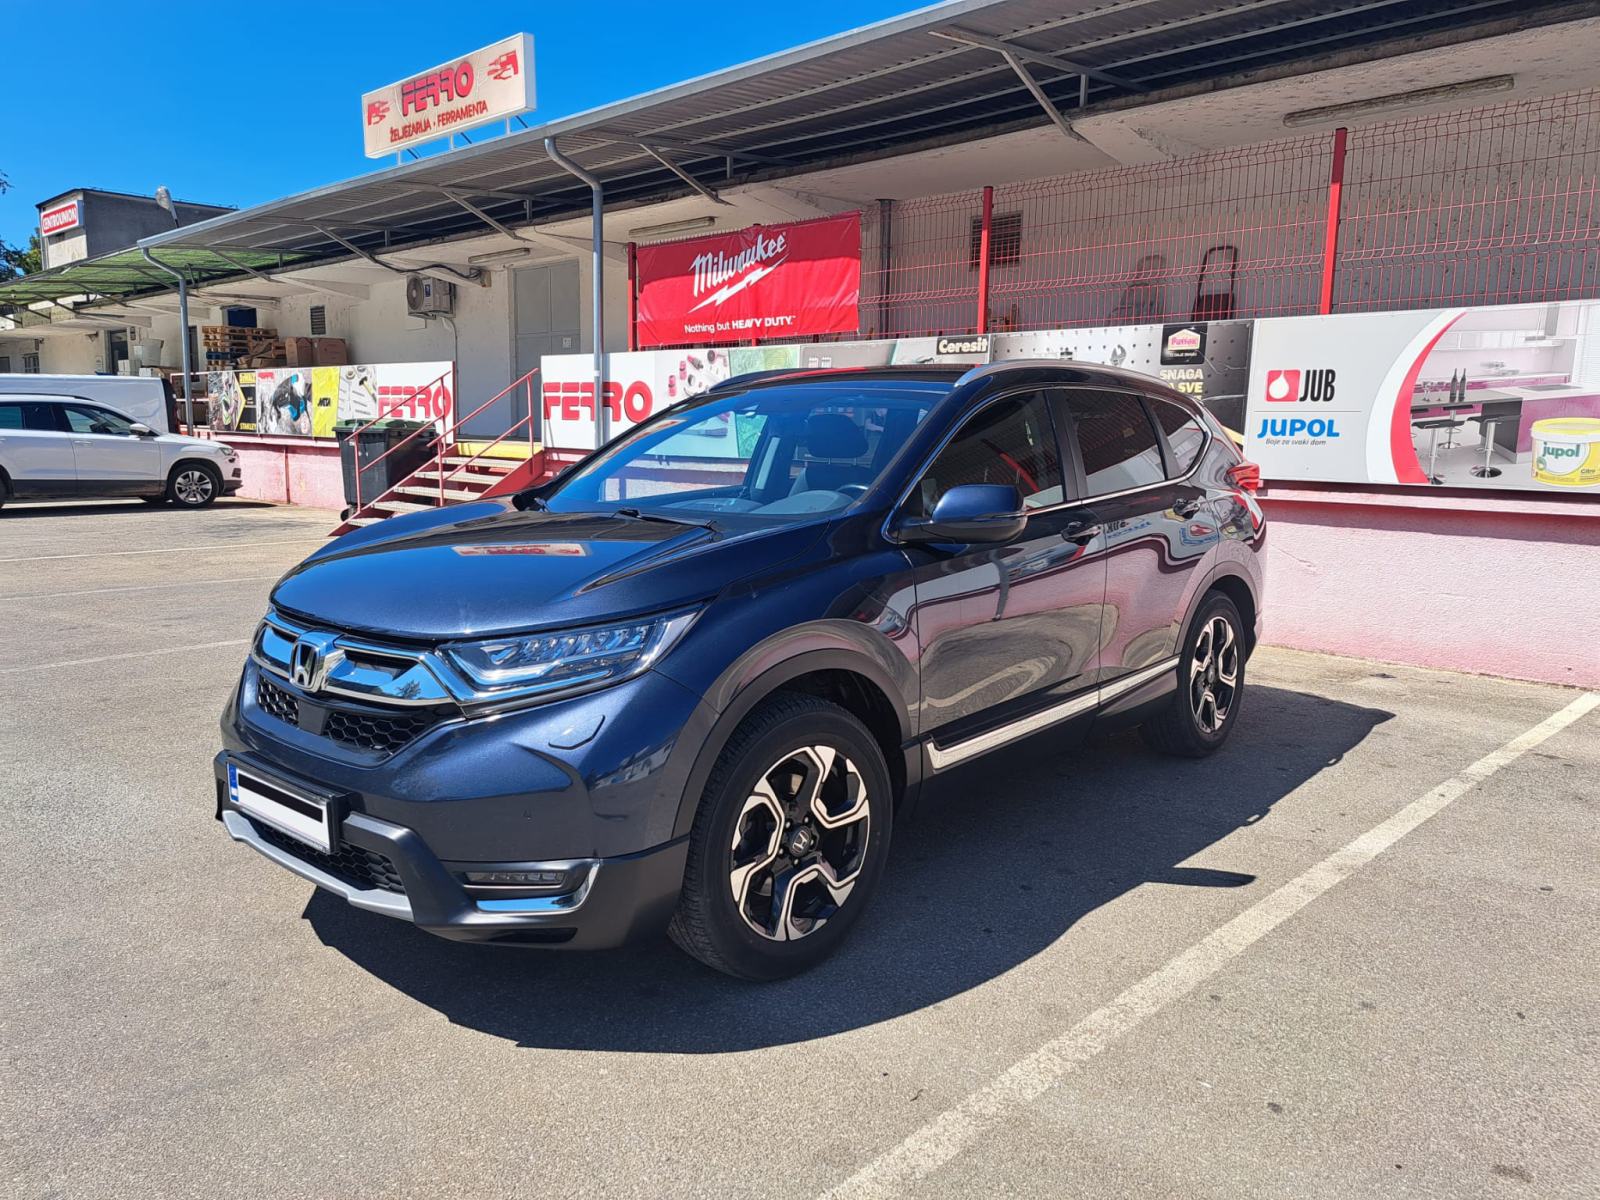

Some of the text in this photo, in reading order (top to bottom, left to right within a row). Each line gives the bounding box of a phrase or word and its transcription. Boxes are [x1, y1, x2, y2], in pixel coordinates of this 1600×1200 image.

[401, 61, 474, 117] FERRO
[437, 100, 488, 126] FERRAMENTA
[689, 233, 787, 298] Milwaukee
[684, 325, 715, 334] Nothing
[717, 322, 730, 331] but
[731, 318, 763, 329] HEAVY
[938, 336, 988, 354] Ceresit
[1160, 368, 1204, 380] SNAGA
[1298, 369, 1336, 402] JUB
[1178, 382, 1204, 393] SVE
[378, 385, 452, 419] FERRO
[543, 380, 653, 423] FERRO
[1257, 418, 1340, 439] JUPOL
[1542, 441, 1581, 459] jupol
